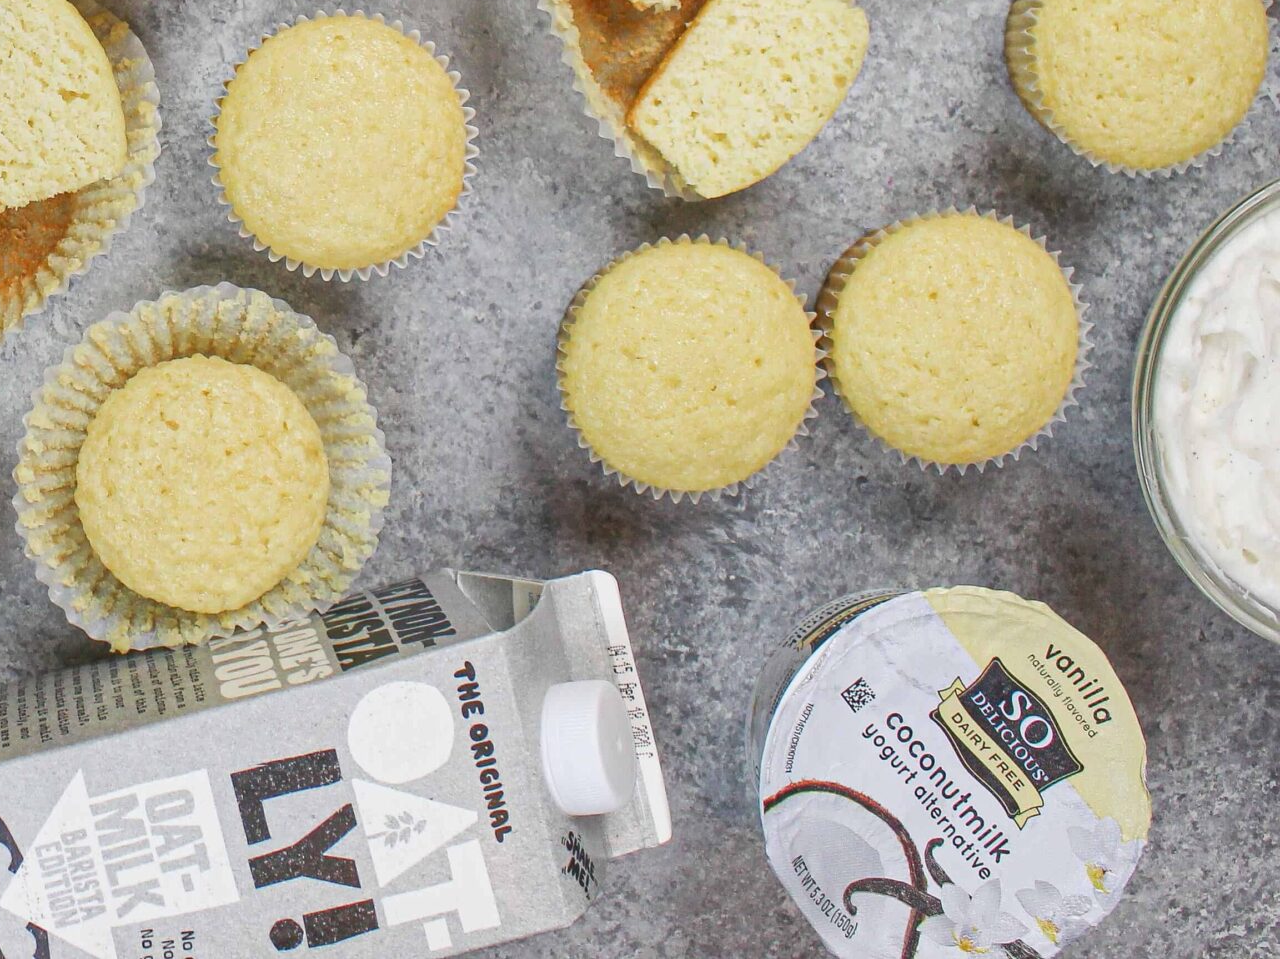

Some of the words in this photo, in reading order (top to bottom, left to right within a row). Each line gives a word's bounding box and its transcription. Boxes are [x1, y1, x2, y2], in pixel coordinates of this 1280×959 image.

[211, 638, 282, 700] YOU
[272, 627, 334, 686] ONE'S
[1045, 643, 1113, 726] vanilla
[453, 660, 485, 720] THE
[998, 690, 1055, 750] SO
[1027, 653, 1065, 699] naturally
[1061, 695, 1100, 740] flavored
[951, 712, 992, 752] DAIRY
[988, 752, 1026, 792] FREE
[468, 722, 514, 845] ORIGINAL
[861, 723, 918, 786] yogurt
[913, 784, 992, 882] alternative
[885, 711, 1012, 865] coconutmilk
[88, 792, 166, 919] MILK
[144, 789, 211, 892] OAT-
[791, 854, 810, 877] NET
[34, 840, 81, 929] EDITION
[59, 827, 108, 923] BARISTA
[799, 870, 817, 891] WT
[808, 885, 827, 907] 5.3
[140, 928, 154, 950] No
[819, 900, 837, 918] OZ
[829, 910, 859, 940] (150g)
[181, 930, 195, 951] No
